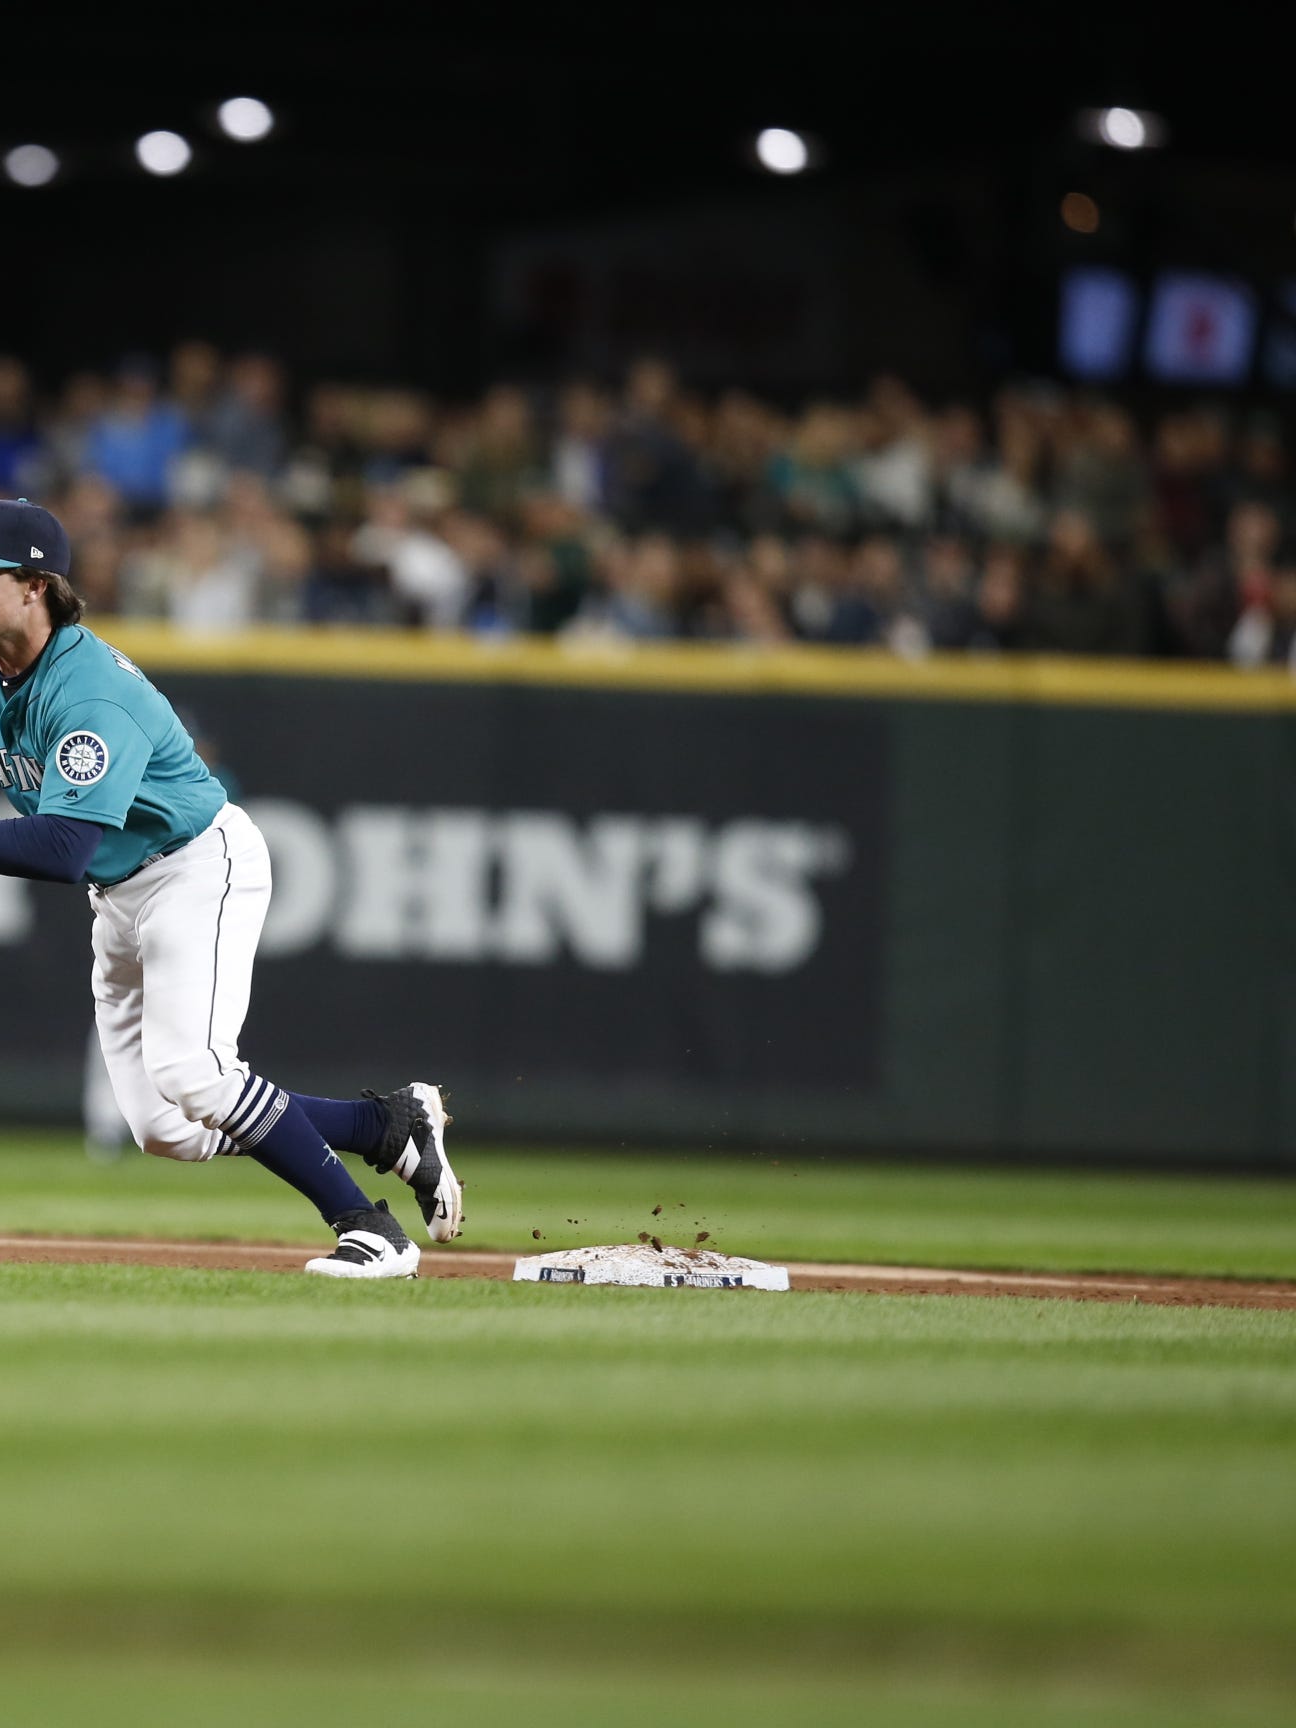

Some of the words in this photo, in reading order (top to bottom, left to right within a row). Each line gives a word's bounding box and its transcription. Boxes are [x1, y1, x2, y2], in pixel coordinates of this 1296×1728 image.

[64, 736, 104, 756] SEATTLE
[61, 760, 102, 780] MARINERS
[244, 799, 821, 973] OHN'S
